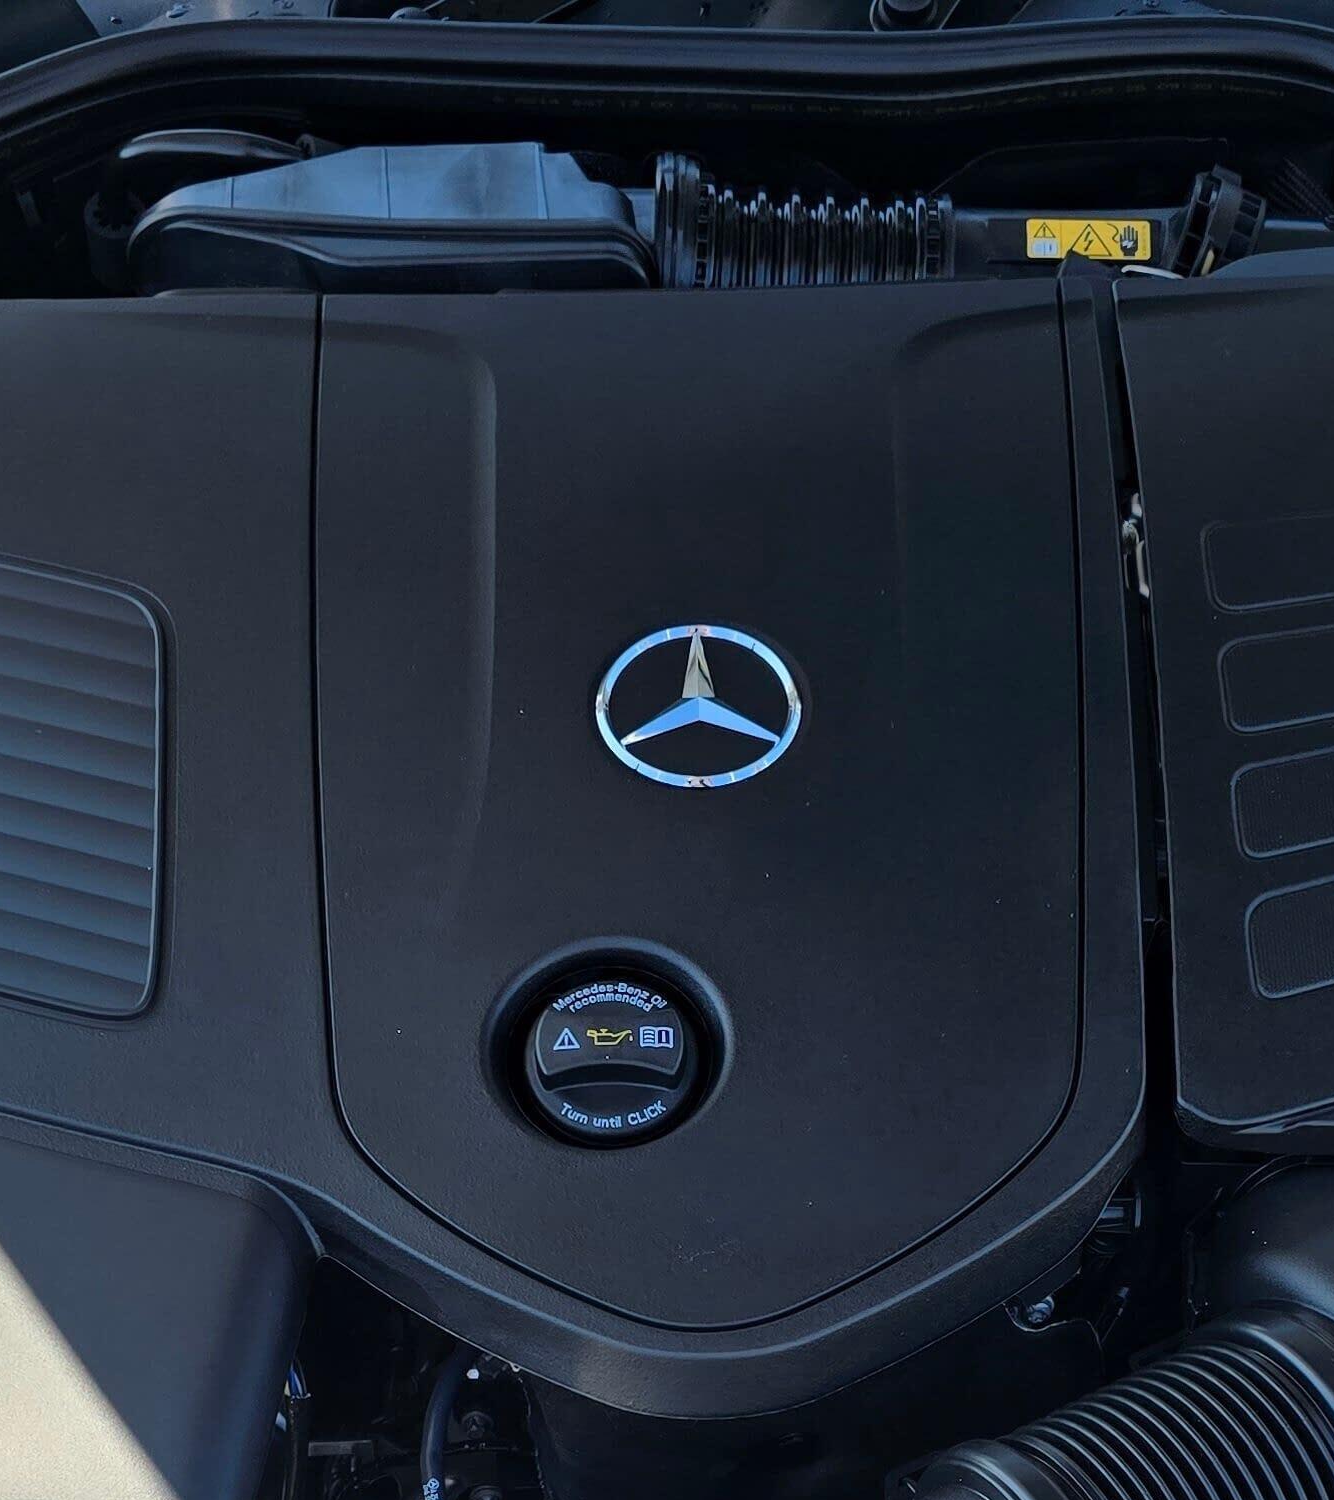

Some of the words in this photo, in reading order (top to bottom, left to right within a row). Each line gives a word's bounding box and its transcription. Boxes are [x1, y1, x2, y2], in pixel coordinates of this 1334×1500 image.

[552, 983, 649, 1012] Mercedes-Benz
[651, 994, 668, 1010] Oil
[569, 992, 653, 1013] recommended
[560, 1102, 589, 1125] Turn
[593, 1114, 622, 1129] until
[627, 1100, 667, 1127] CLICK
